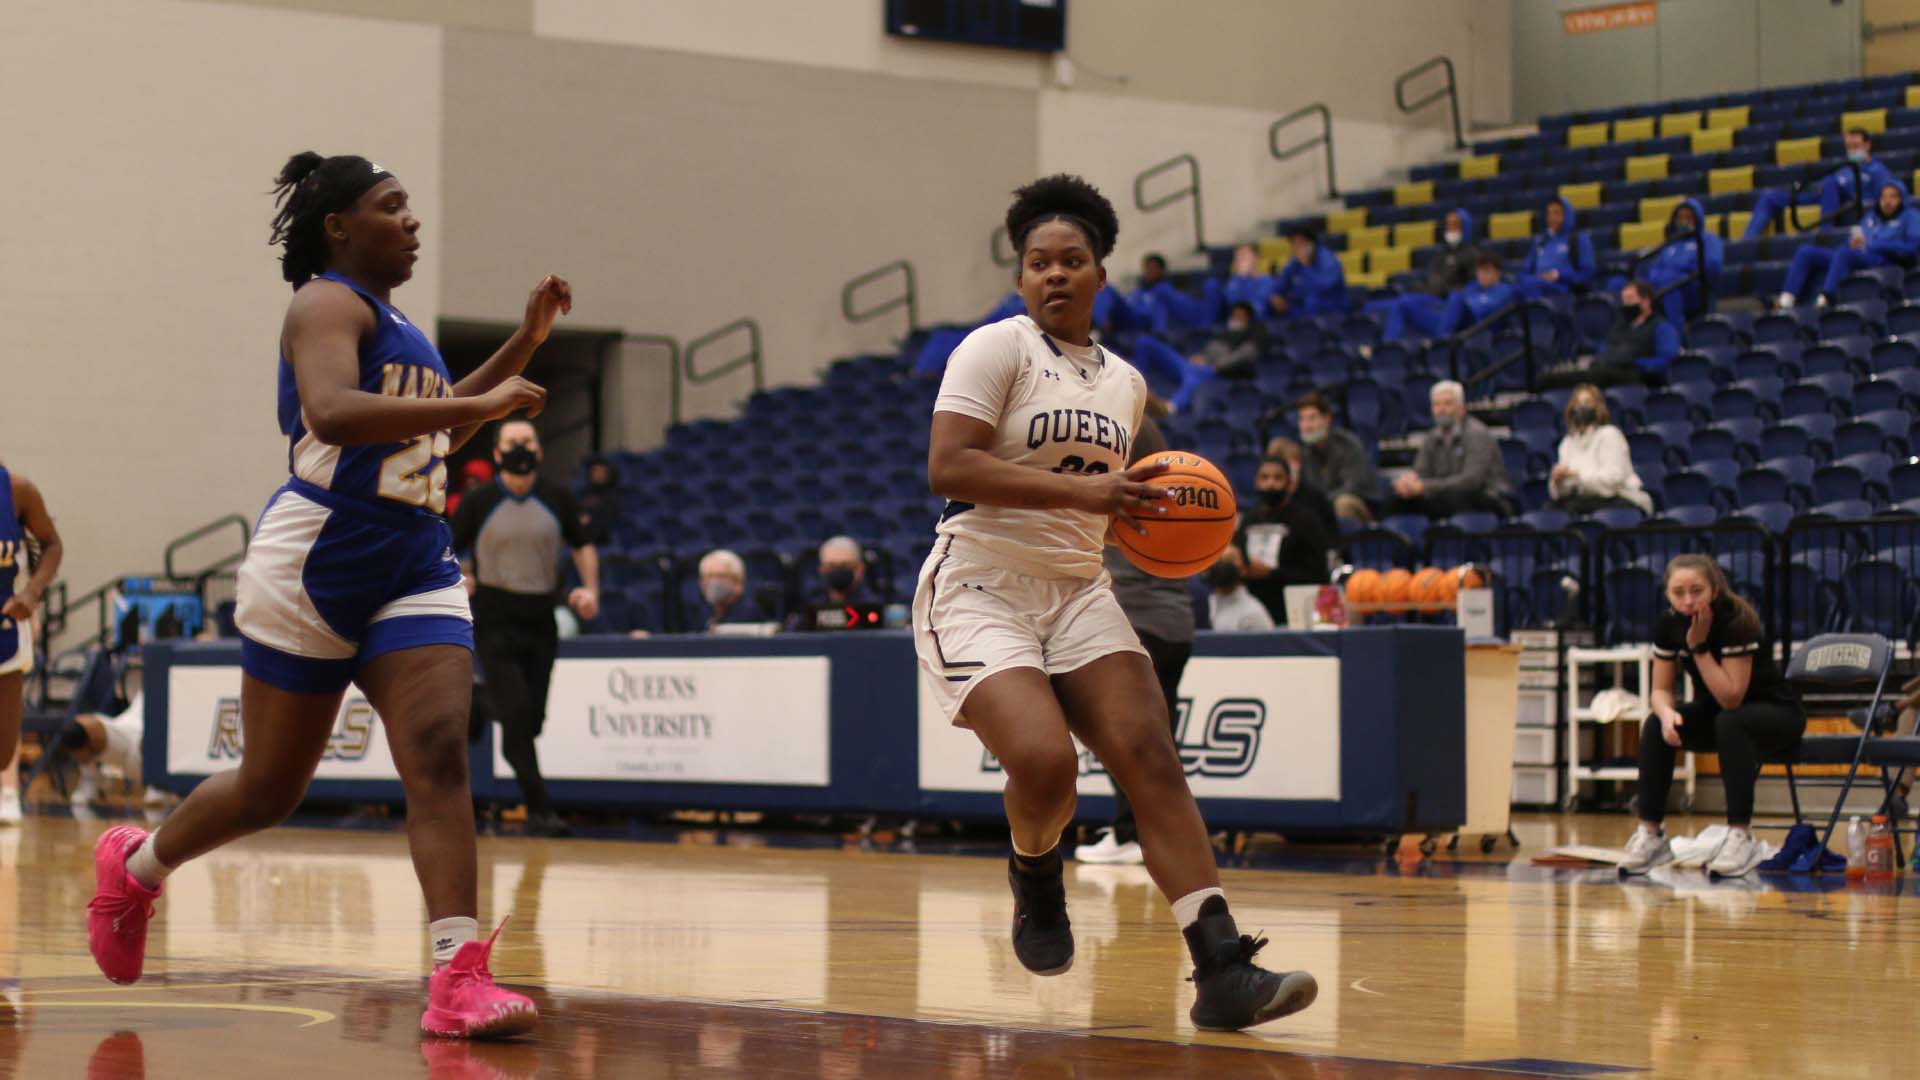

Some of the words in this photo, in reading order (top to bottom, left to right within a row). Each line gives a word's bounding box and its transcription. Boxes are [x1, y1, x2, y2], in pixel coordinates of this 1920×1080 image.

[1027, 408, 1131, 461] QUEEN
[1166, 486, 1219, 510] Wil
[607, 666, 697, 704] QUEENS
[588, 704, 714, 738] UNIVERSITY
